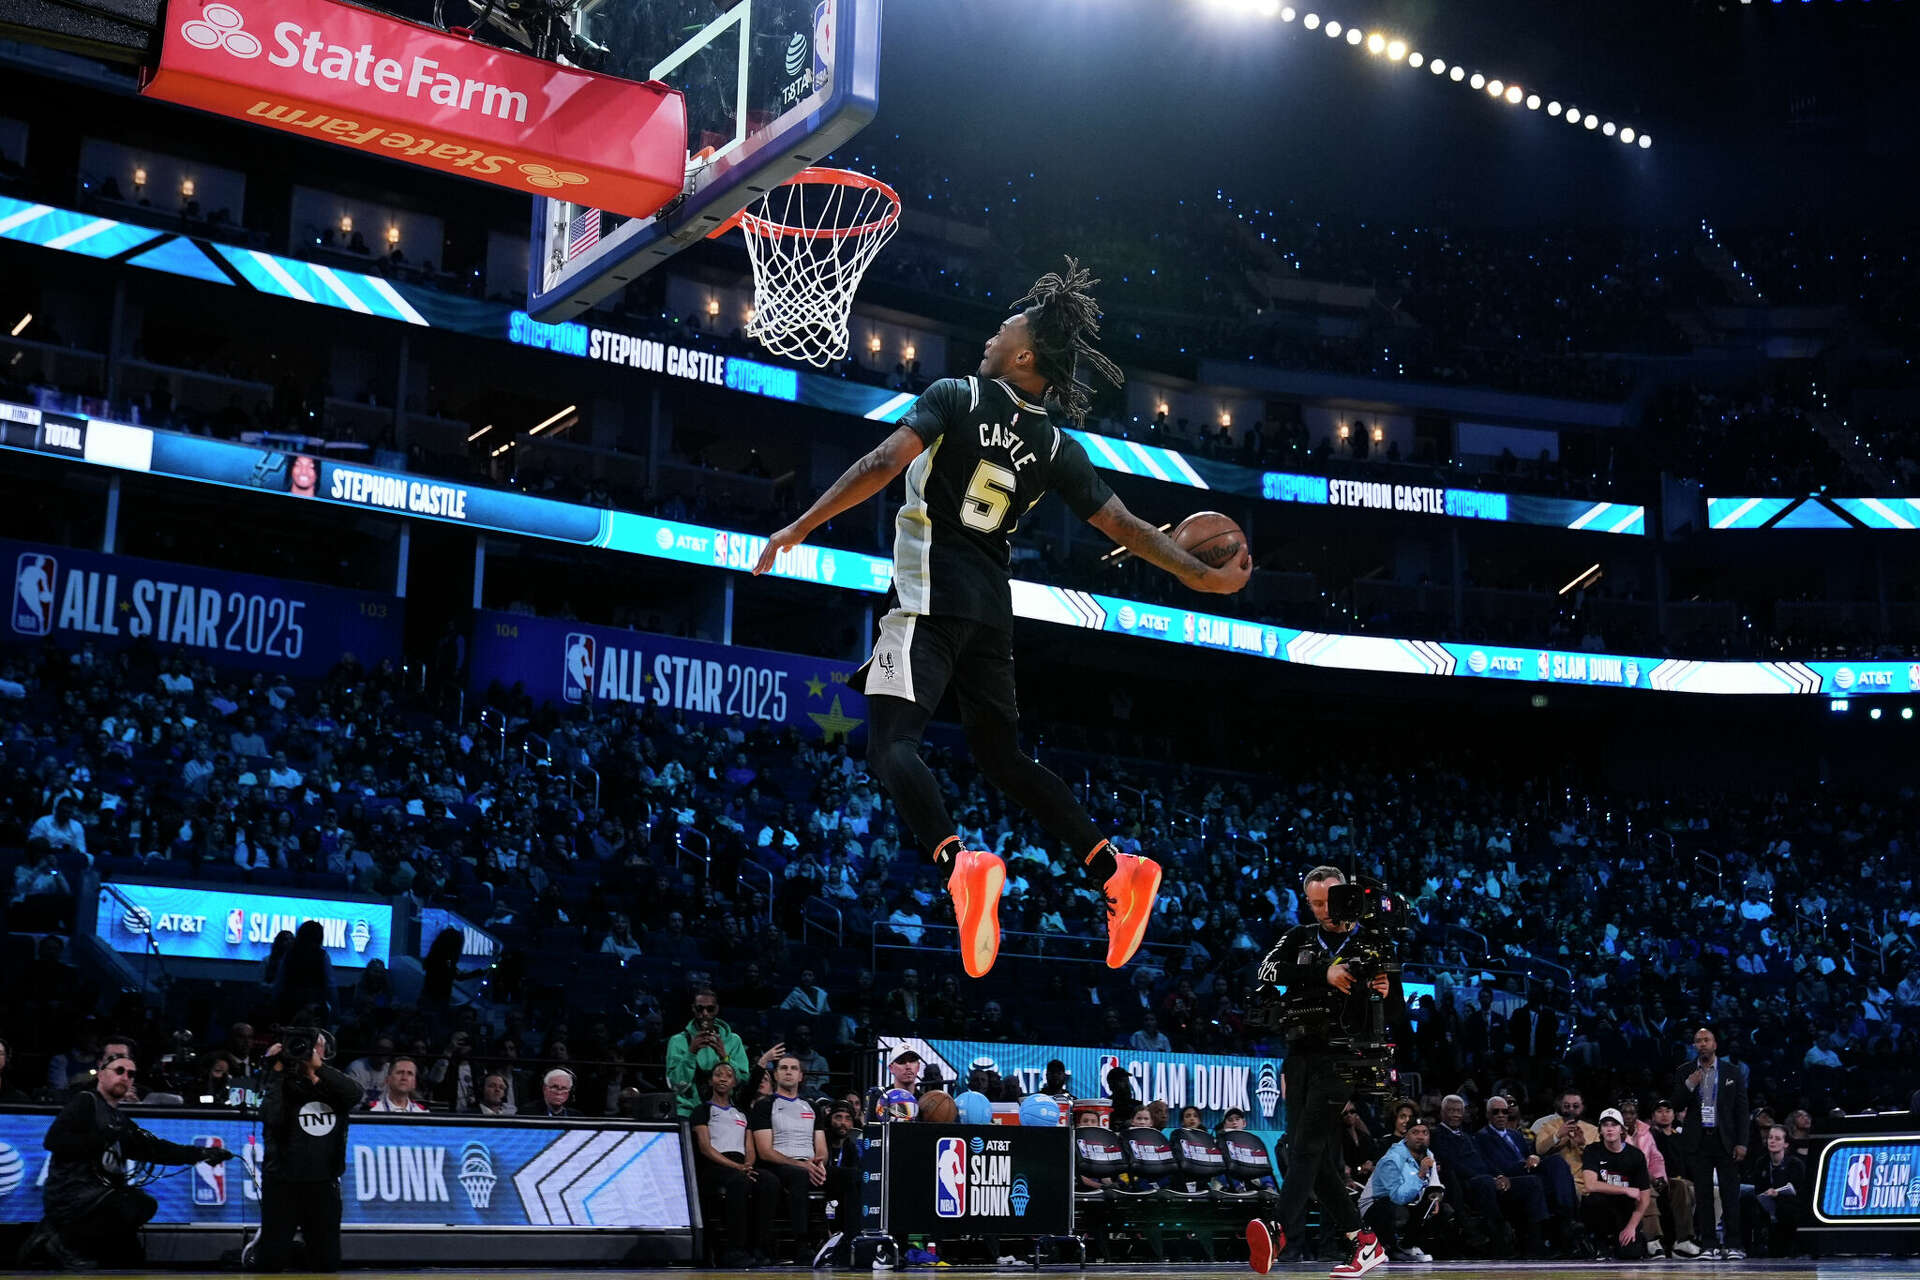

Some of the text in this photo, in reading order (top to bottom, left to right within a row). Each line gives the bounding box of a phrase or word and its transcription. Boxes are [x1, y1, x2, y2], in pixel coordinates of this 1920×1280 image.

[590, 329, 664, 373] STEPHON
[667, 346, 724, 385] CASTLE
[726, 357, 797, 400] STEPHON
[45, 423, 81, 450] TOTAL
[979, 423, 1037, 471] CASTLE
[331, 468, 467, 519] STEPHON CASTLE
[960, 458, 1017, 533] 5
[1263, 472, 1327, 504] STEPHON
[1330, 479, 1392, 509] STEPHON
[1395, 485, 1444, 514] CASTLE
[676, 535, 708, 552] AT&T
[59, 569, 305, 659] ALL STAR 2025
[359, 602, 388, 618] 103
[1138, 613, 1171, 631] AT&T
[496, 623, 518, 639] 104
[1199, 617, 1263, 652] SLAM DUNK
[1490, 656, 1523, 672] AT&T
[1553, 655, 1622, 683] SLAM DUNK
[599, 647, 788, 722] ALL STAR 2025
[1857, 671, 1893, 685] AT&T
[157, 913, 207, 933] AT&T
[1129, 1061, 1251, 1112] SLAM DUNK
[299, 1112, 336, 1128] TNT
[986, 1140, 1011, 1151] AT&T
[1889, 1153, 1912, 1162] AT&T
[354, 1145, 449, 1202] DUNK
[970, 1155, 1011, 1185] SLAM
[1873, 1164, 1910, 1186] SLAM
[939, 1199, 955, 1212] NBA
[970, 1186, 1011, 1217] DUNK
[1870, 1186, 1908, 1208] DUNK
